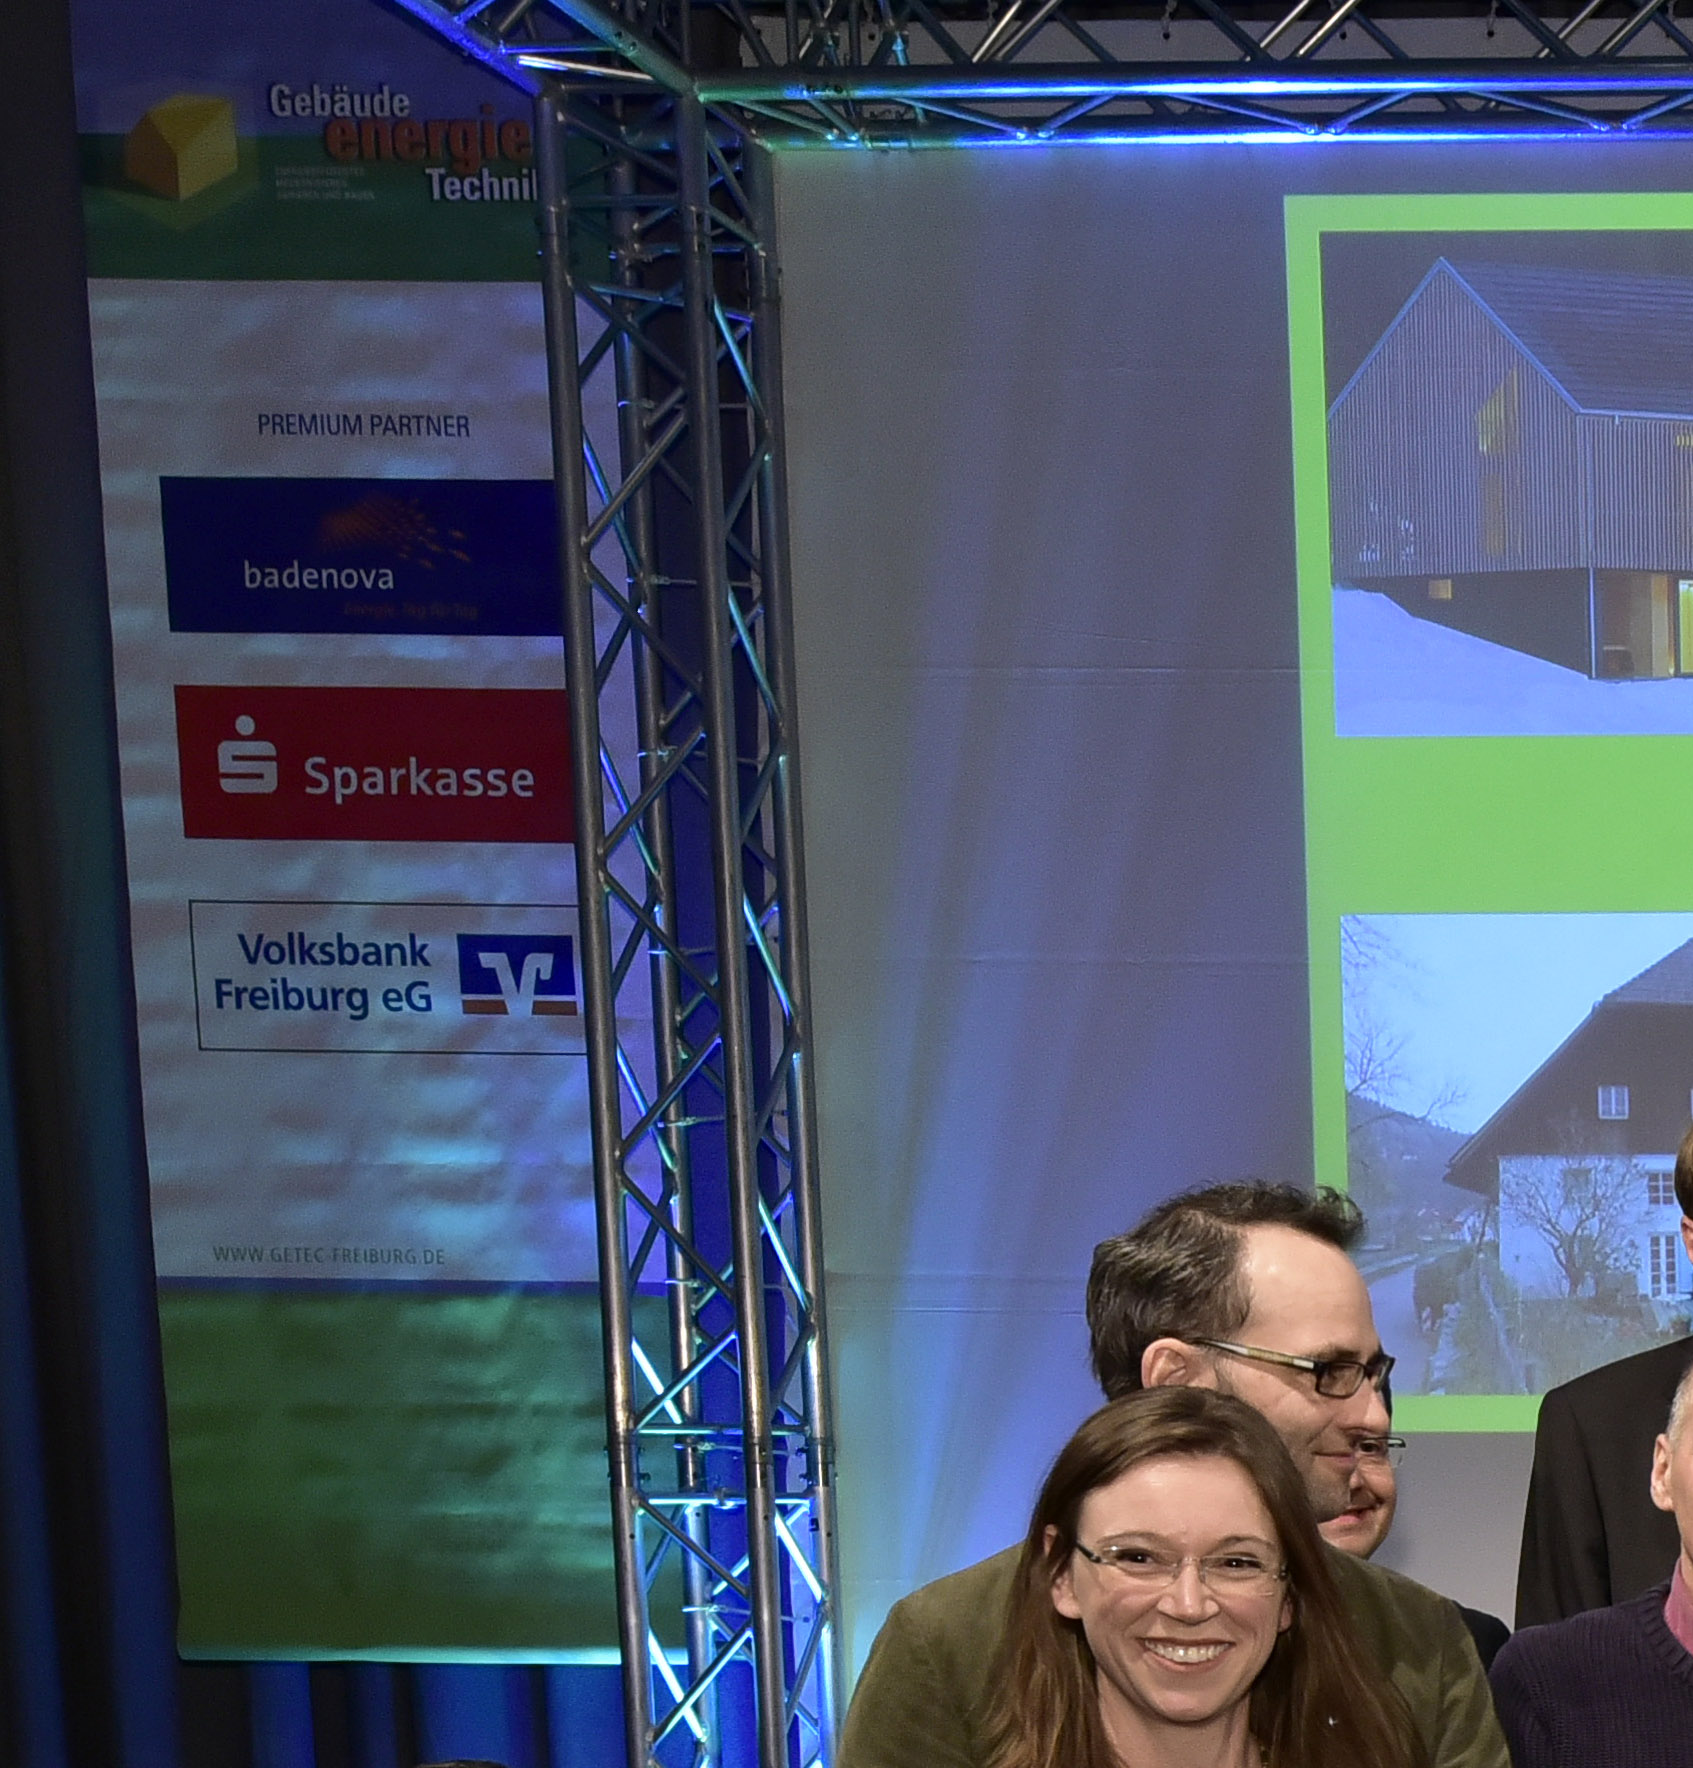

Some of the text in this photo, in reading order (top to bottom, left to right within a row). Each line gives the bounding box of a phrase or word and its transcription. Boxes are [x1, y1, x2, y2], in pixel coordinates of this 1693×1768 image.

[270, 83, 411, 118] Gebäude
[325, 105, 533, 174] energie
[258, 413, 470, 438] PREMIUM PARTNER
[244, 560, 395, 591] badenova
[304, 756, 535, 804] Sparkasse
[237, 932, 430, 967] Volksbank
[214, 978, 432, 1020] Freiburg eG
